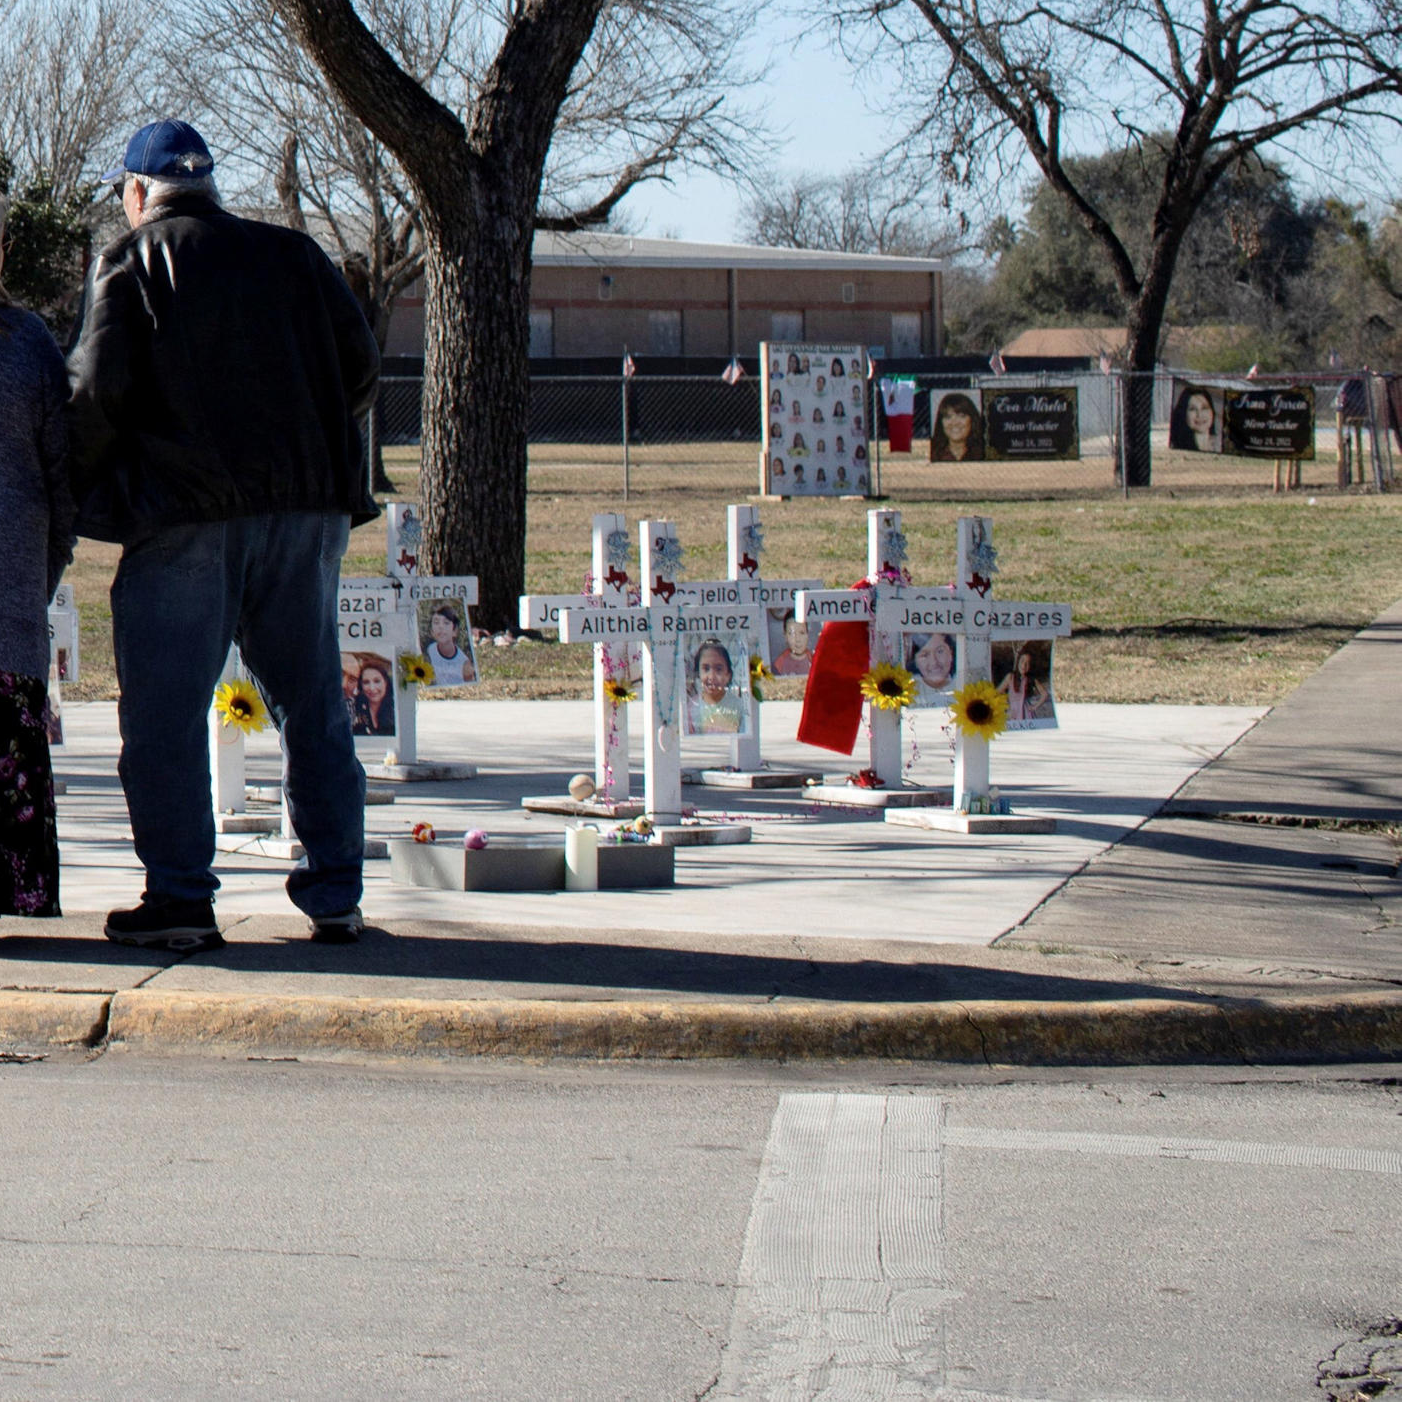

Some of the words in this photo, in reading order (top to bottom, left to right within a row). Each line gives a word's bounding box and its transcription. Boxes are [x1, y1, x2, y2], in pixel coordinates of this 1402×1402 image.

[749, 587, 810, 602] Torre
[339, 597, 386, 613] azar
[581, 616, 647, 635] Alithia
[662, 614, 750, 632] Ramirez
[901, 608, 963, 626] Jackie
[973, 609, 1063, 629] Cazares
